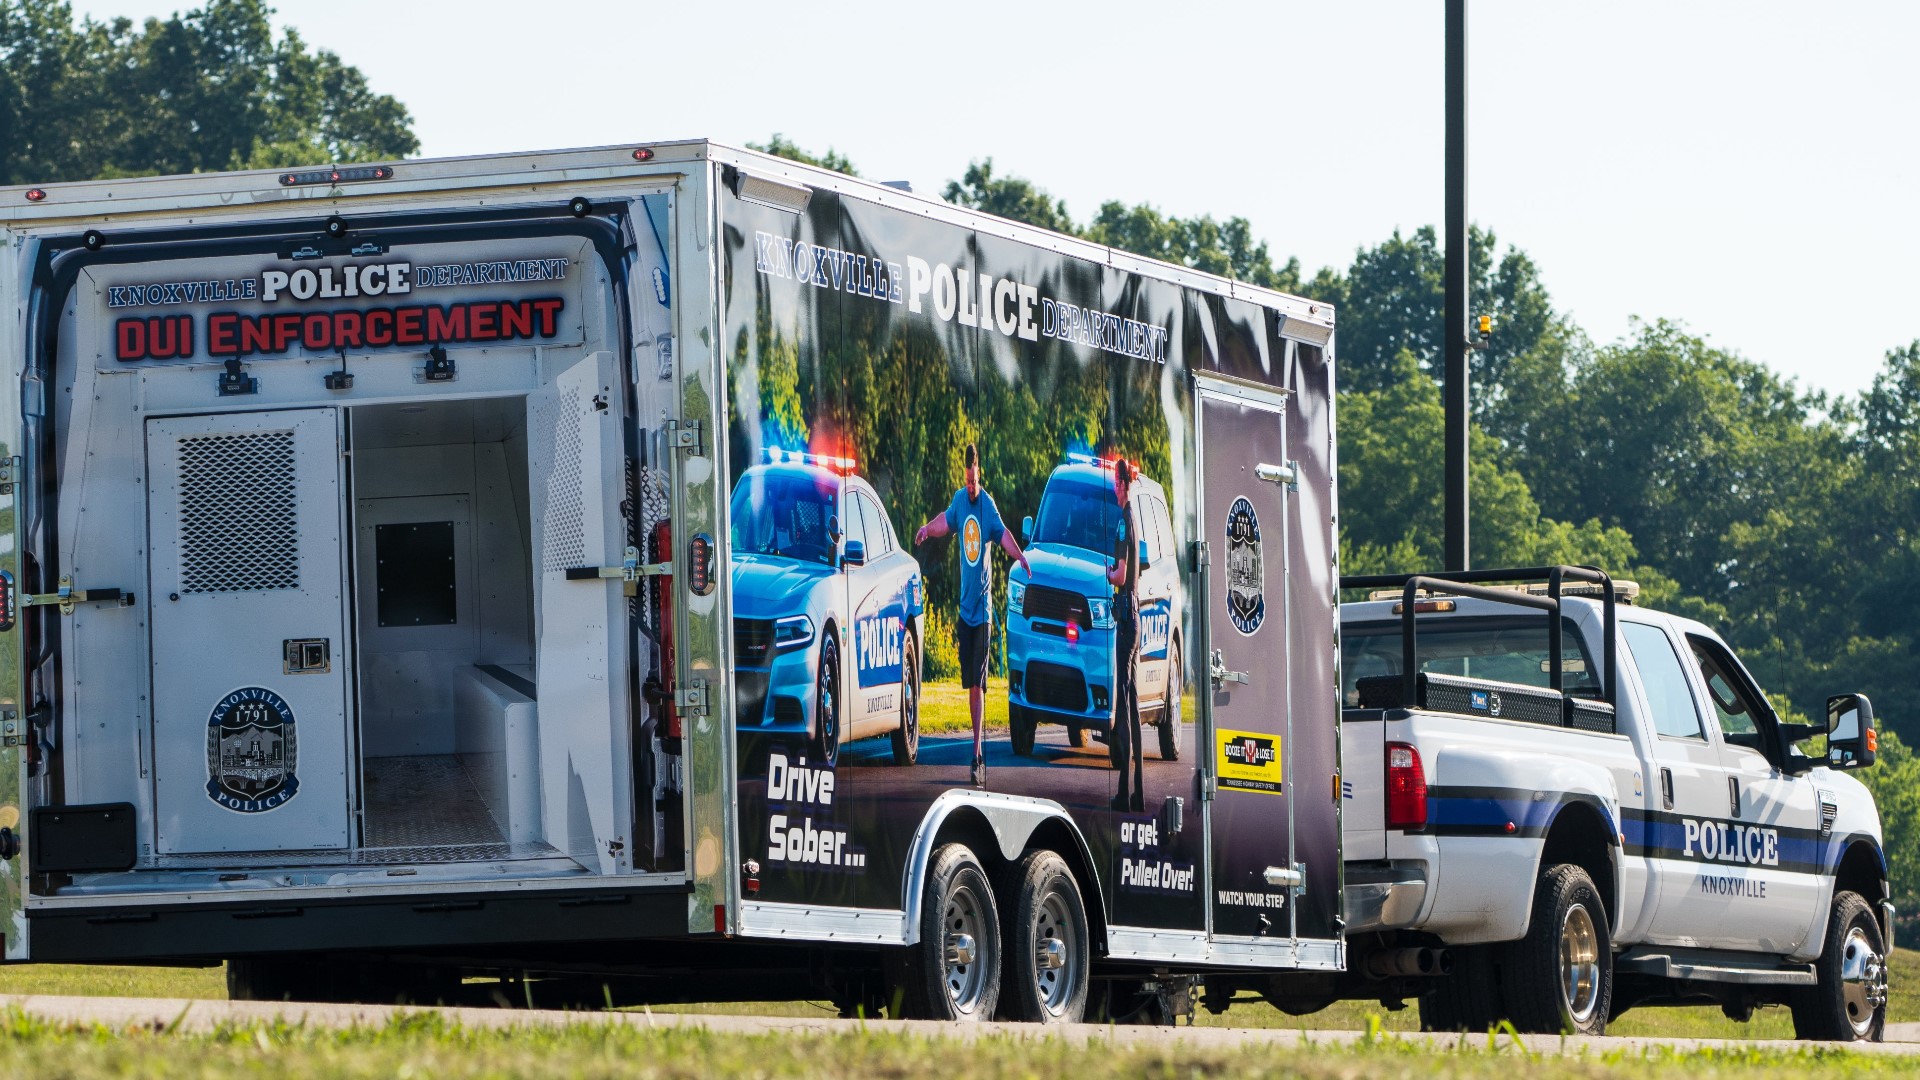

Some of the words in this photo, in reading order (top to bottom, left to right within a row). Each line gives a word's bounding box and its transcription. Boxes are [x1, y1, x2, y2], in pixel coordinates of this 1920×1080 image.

[109, 278, 257, 307] KNOXVILLE
[262, 263, 411, 301] POLICE
[416, 258, 568, 288] DEPARTMENT
[756, 231, 903, 304] KNOXVILLE
[907, 255, 1038, 342] POLICE
[1042, 297, 1168, 364] DEPARTMENT
[117, 316, 192, 360] DUI
[209, 300, 562, 354] ENFORCEMENT
[1227, 501, 1259, 536] KNOXVILLE
[1236, 522, 1251, 537] 1791
[1141, 614, 1168, 650] POLICE
[1231, 609, 1262, 632] POLICE
[860, 616, 900, 670] POLICE
[213, 689, 290, 722] KNOXVILLE
[235, 709, 269, 723] 1791
[1225, 744, 1240, 757] BOOZE
[767, 753, 835, 805] Drive
[216, 789, 290, 811] POLICE
[768, 814, 865, 867] Sober...
[1120, 822, 1135, 844] or
[1137, 819, 1158, 850] get
[1682, 818, 1779, 867] POLICE
[1121, 858, 1161, 888] Pulled
[1162, 862, 1194, 891] Over!
[1701, 875, 1766, 899] KNOXVILLE
[1218, 890, 1244, 906] WATCH
[1245, 892, 1265, 907] YOUR
[1265, 894, 1285, 909] STEP
